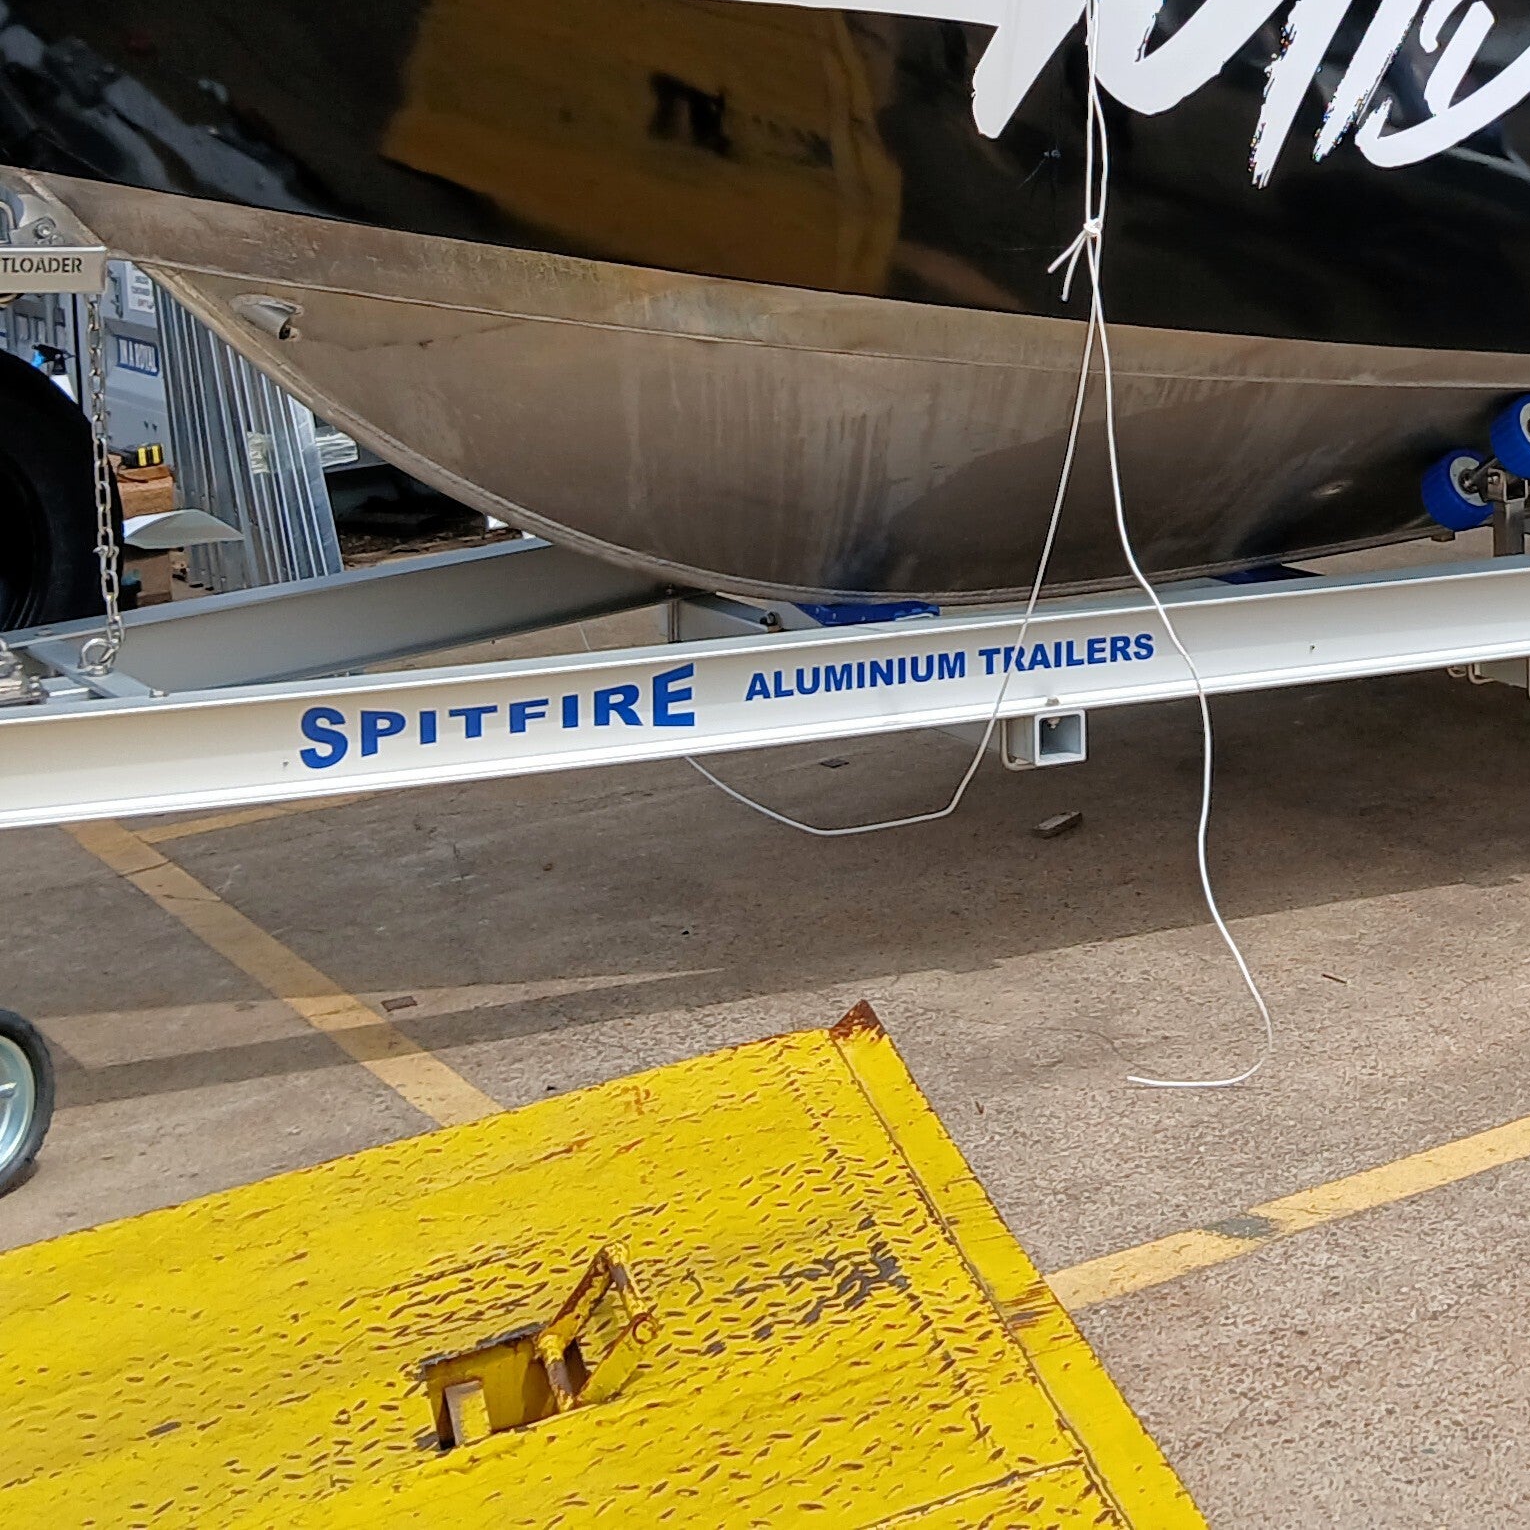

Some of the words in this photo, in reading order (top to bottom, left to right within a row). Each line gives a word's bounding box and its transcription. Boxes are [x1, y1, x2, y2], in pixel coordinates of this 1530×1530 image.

[300, 662, 696, 770] SPITFIRE
[745, 648, 966, 701] ALUMINIUM
[978, 633, 1154, 675] TRAILERS
